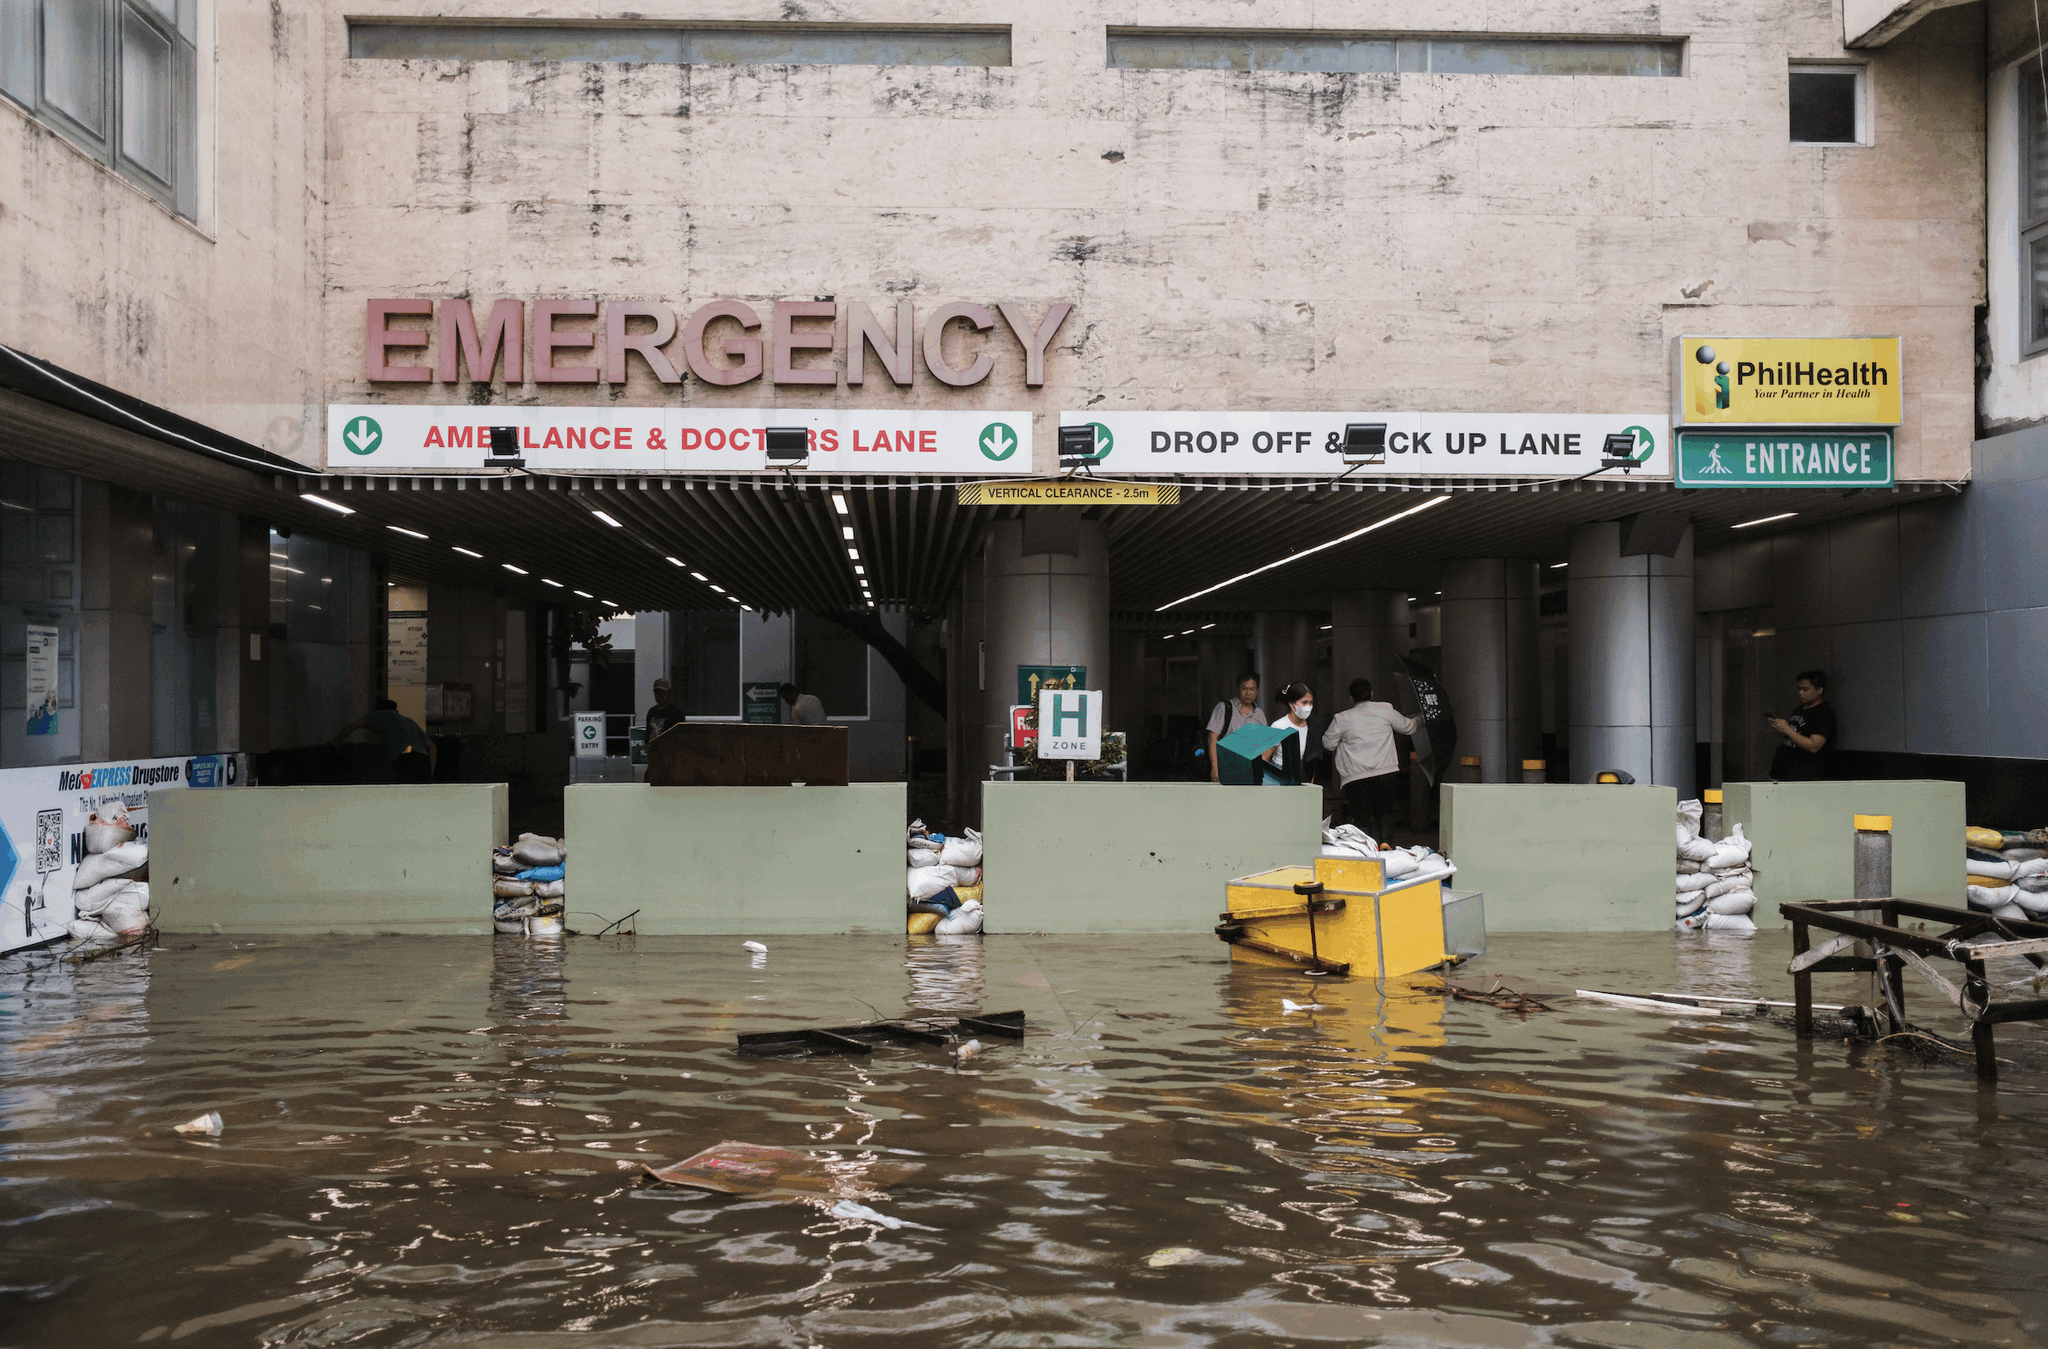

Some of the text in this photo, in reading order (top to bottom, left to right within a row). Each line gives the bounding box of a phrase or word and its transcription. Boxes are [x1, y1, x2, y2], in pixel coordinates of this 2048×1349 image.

[366, 299, 1073, 388] EMERGENCY
[1737, 361, 1888, 386] PhilHealth
[1754, 389, 1871, 399] Your Partner in Health
[423, 425, 938, 453] AMBLANCE & DOCTRS LANE
[1150, 430, 1240, 454] DROP
[1252, 430, 1312, 454] OFF
[1324, 431, 1344, 454] &
[1446, 432, 1487, 455] UP
[1499, 433, 1582, 455] LANE
[1745, 442, 1871, 474] ENTRANCE
[988, 487, 1042, 499] VERTICAL
[1045, 487, 1114, 499] CLEARANCE
[1123, 487, 1150, 499] 2.5m
[1053, 694, 1087, 738] H
[90, 765, 132, 789] EXPRESS
[132, 764, 180, 787] Drugstore
